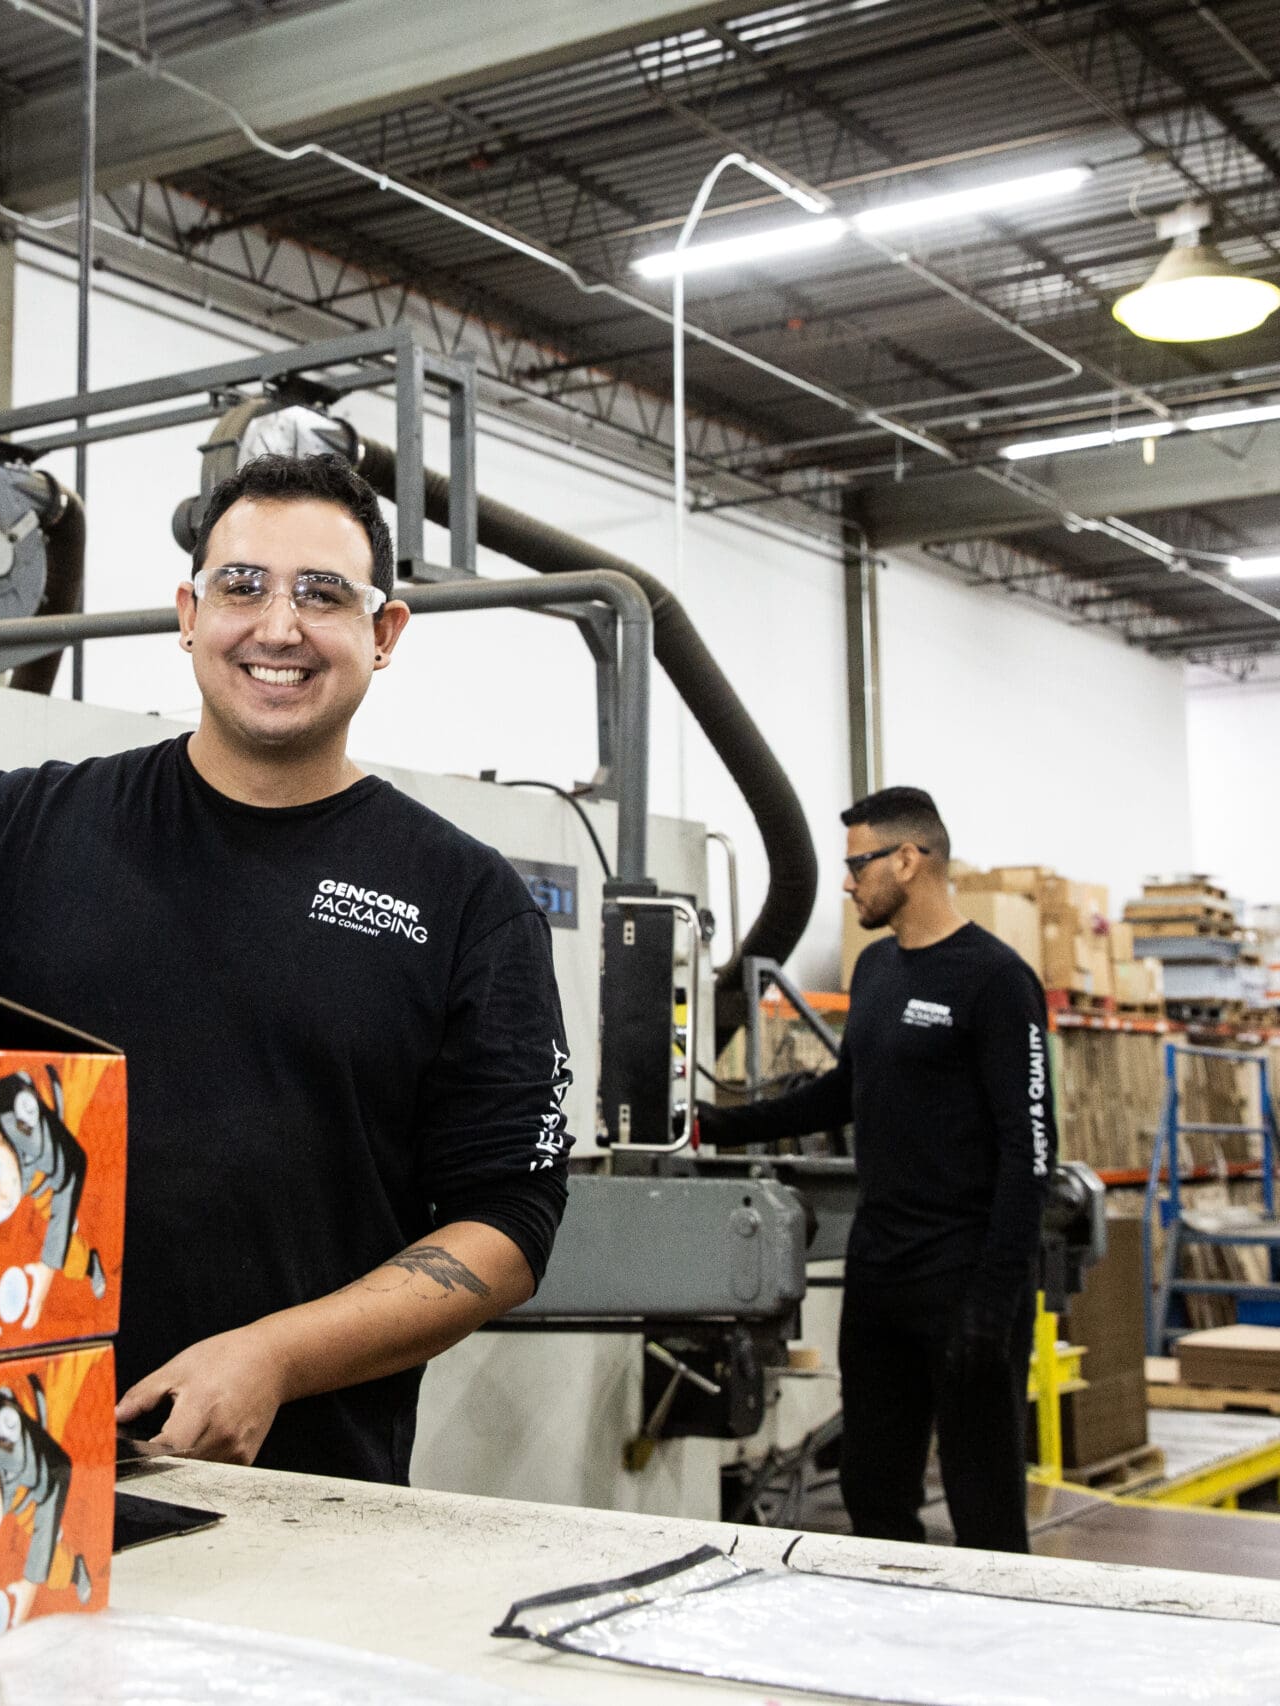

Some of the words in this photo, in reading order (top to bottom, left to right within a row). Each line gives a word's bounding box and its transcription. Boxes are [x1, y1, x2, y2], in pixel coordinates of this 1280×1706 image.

[318, 879, 421, 923] GENCORR
[308, 911, 316, 919] A
[338, 918, 381, 937] COMPANY
[311, 894, 428, 944] PACKAGING
[1028, 1102, 1045, 1118] &
